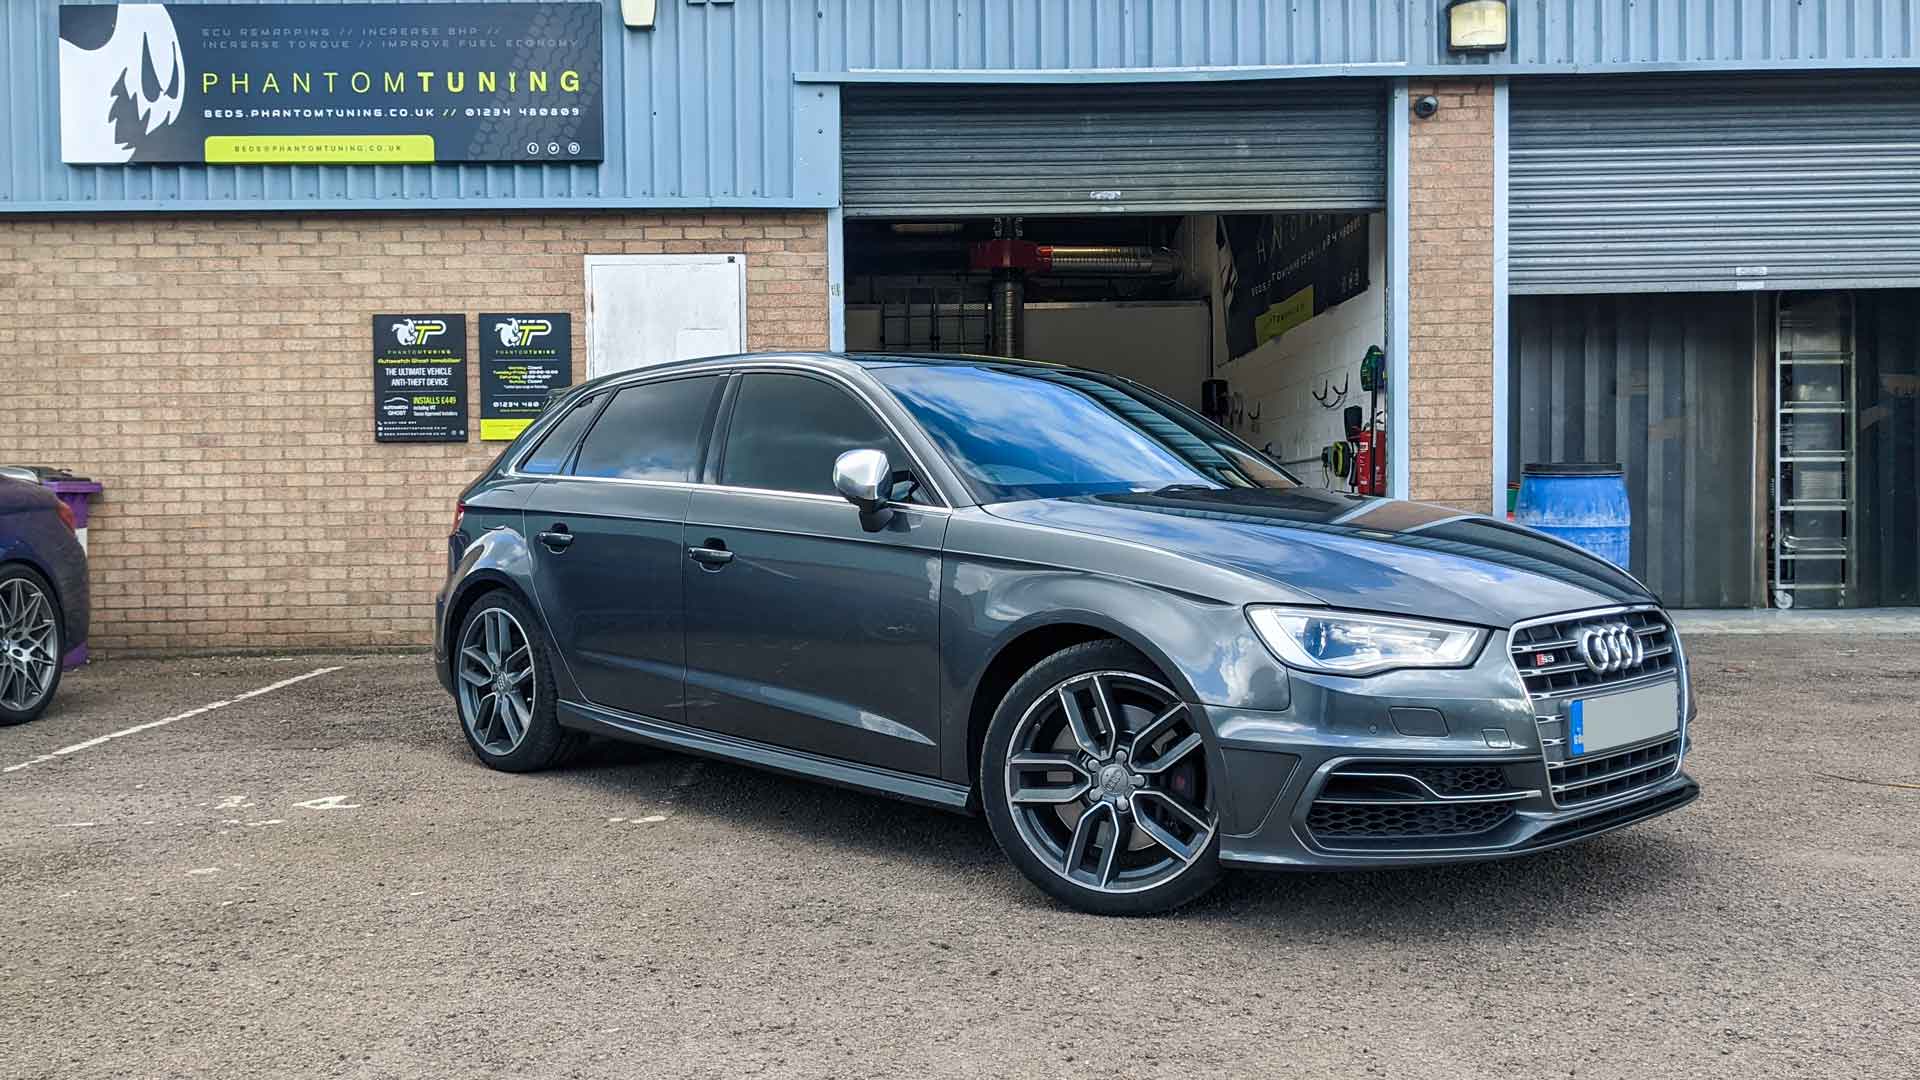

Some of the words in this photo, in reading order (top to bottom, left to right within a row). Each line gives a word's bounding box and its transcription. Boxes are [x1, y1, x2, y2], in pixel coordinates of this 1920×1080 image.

[201, 28, 231, 37] ECU
[240, 27, 329, 37] REMAPPING
[362, 27, 440, 36] INCREASE
[448, 27, 479, 36] BHP
[202, 40, 280, 49] INCREASE
[289, 40, 352, 49] TORQUE
[381, 39, 450, 48] IMPROVE
[459, 39, 497, 48] FUEL
[506, 39, 580, 48] ECONOMY
[204, 108, 435, 118] BEDS.PHANTOMTUNING.CO.UK
[465, 108, 511, 117] 01234
[519, 107, 580, 117] 480809
[385, 367, 398, 376] THE
[398, 367, 426, 376] ULTIMATE
[426, 367, 453, 376] VEHICLE
[391, 377, 426, 386] ANTI-THEFT
[426, 377, 449, 386] DEVICE
[412, 396, 440, 405] INSTALLS
